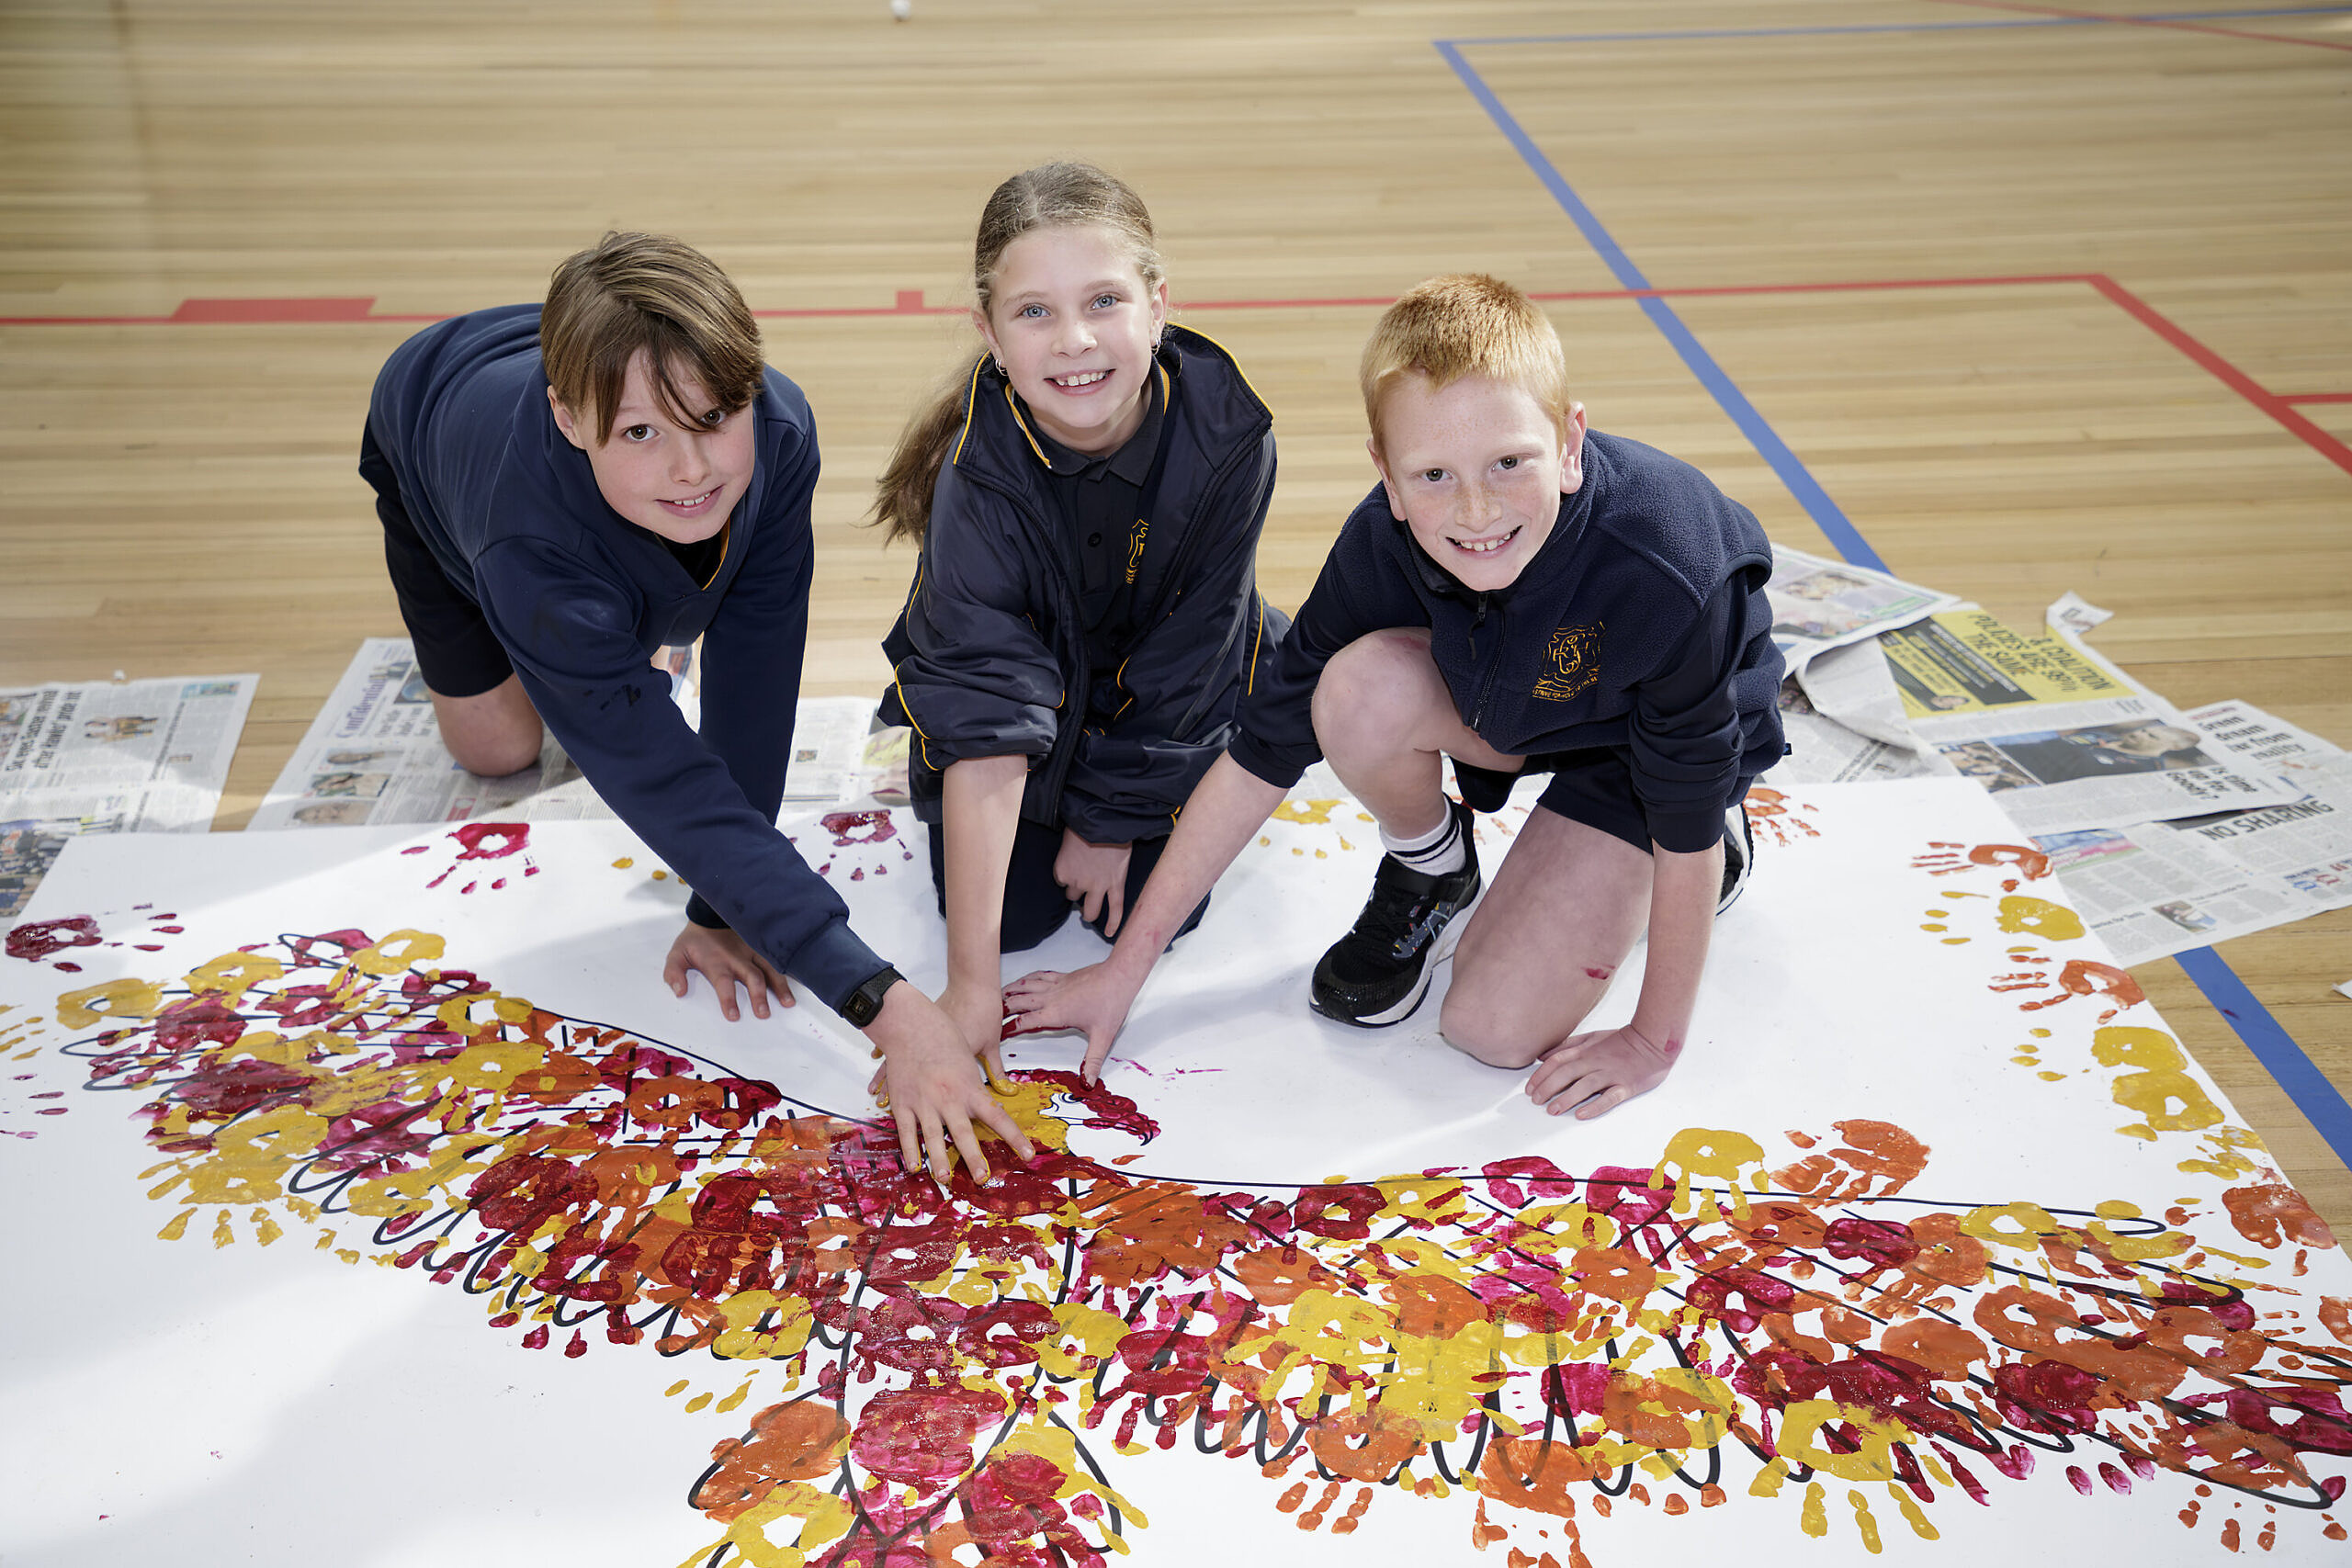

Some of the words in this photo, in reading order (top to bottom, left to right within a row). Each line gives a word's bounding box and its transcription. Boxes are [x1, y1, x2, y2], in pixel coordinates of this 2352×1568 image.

[1968, 614, 2030, 650] POLICIES
[2040, 646, 2116, 691] COALITION
[2197, 716, 2245, 732] Green
[2214, 725, 2267, 742] dream
[2248, 732, 2294, 747] from
[2197, 825, 2238, 841] NO
[2233, 799, 2335, 833] SHARING
